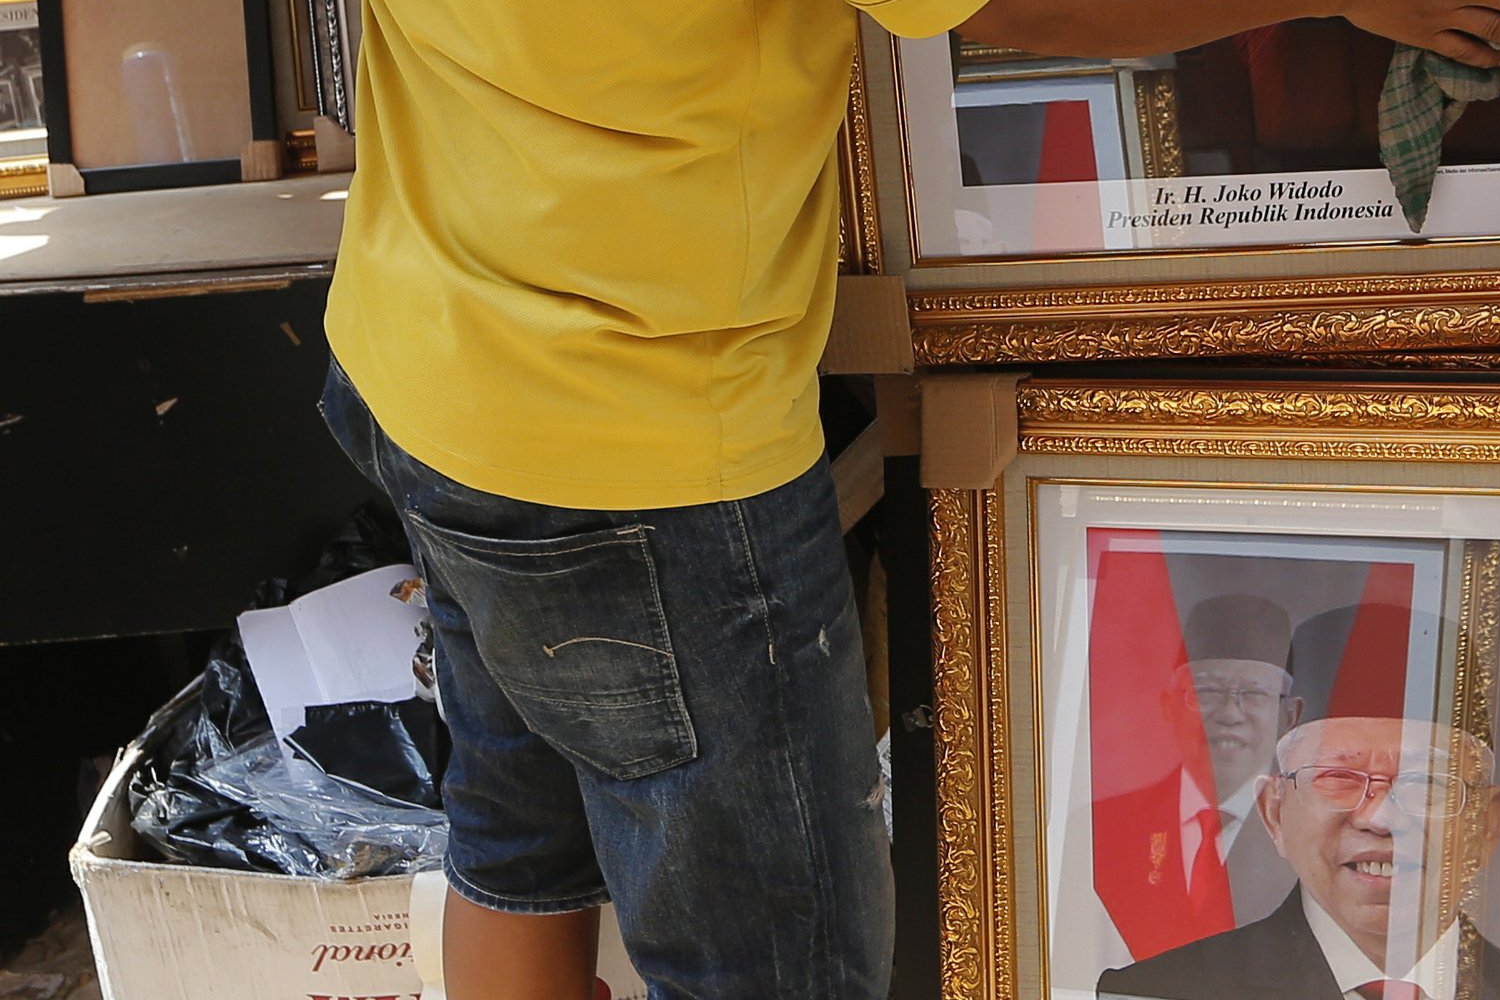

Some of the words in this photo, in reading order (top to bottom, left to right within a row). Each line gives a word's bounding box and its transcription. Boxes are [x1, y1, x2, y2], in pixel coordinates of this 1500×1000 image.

[1155, 187, 1176, 205] Ir.
[1183, 186, 1206, 204] H.
[1213, 184, 1262, 204] Joko
[1268, 180, 1343, 201] Widodo
[1106, 208, 1193, 229] Presiden
[1199, 204, 1289, 231] Republik
[1293, 200, 1394, 222] Indonesia
